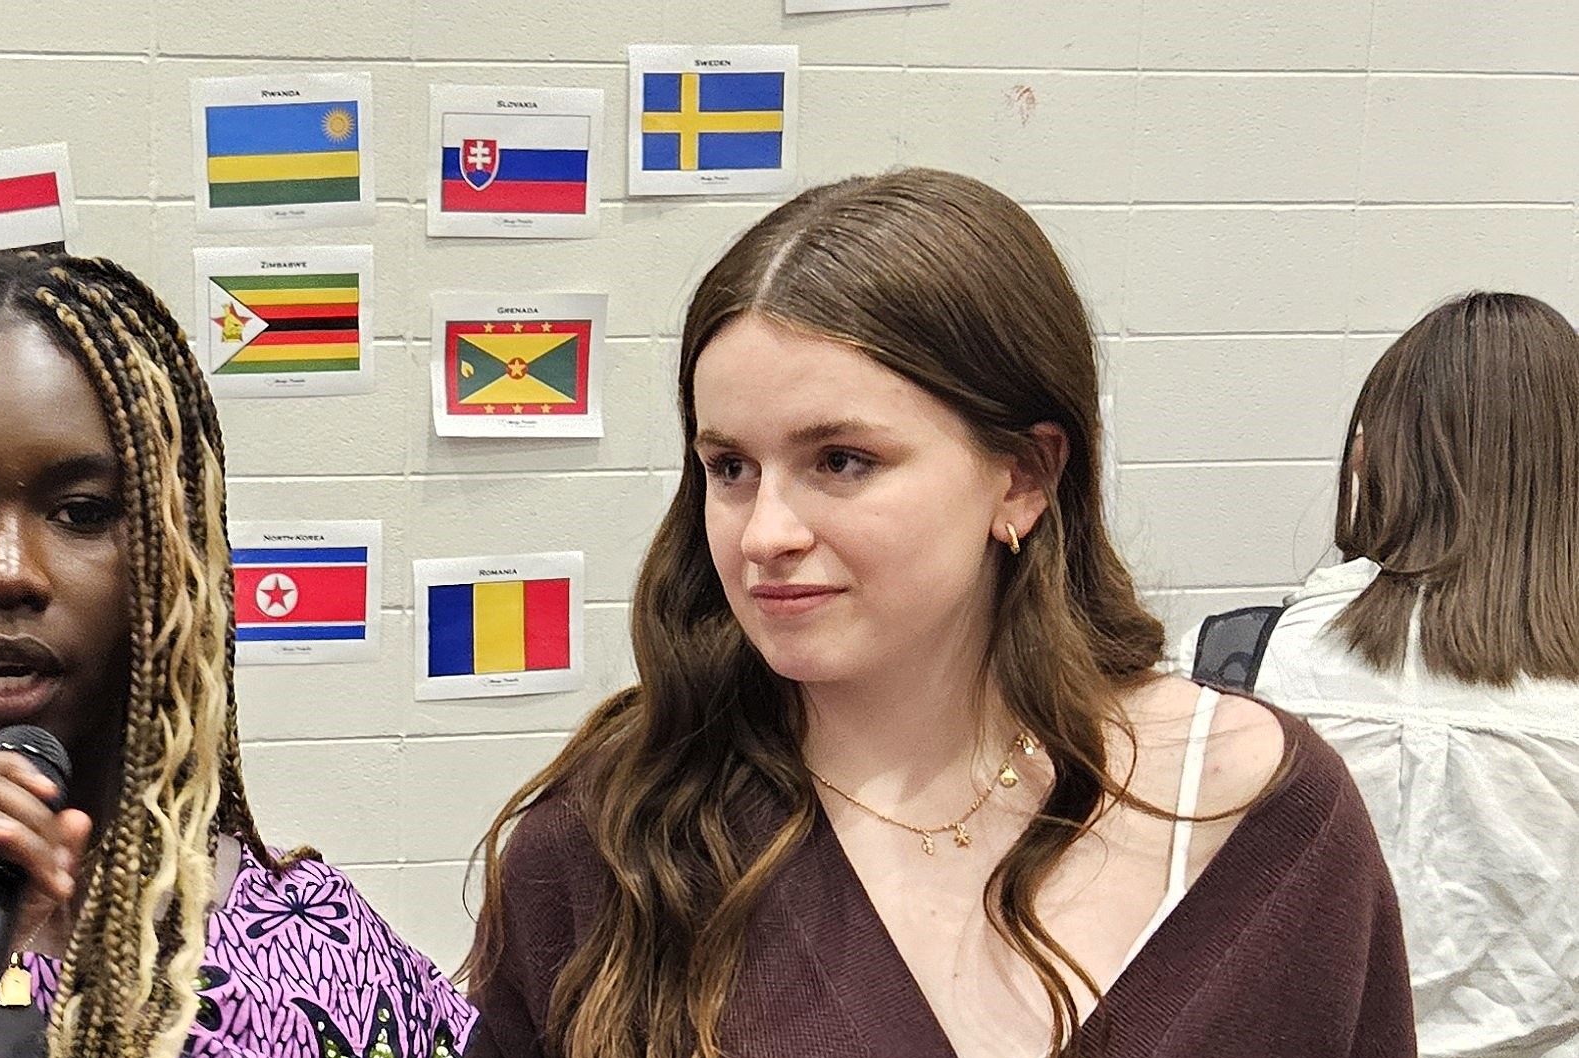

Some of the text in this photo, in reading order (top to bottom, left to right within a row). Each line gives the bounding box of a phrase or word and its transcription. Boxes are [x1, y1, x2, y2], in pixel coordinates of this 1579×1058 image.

[694, 59, 732, 67] SWEDEN
[261, 89, 301, 98] RWANDA
[496, 99, 538, 109] SLOVAKIA
[260, 260, 308, 270] ZIMBABWE
[497, 305, 539, 314] GRENADA
[479, 567, 518, 577] ROMANIA
